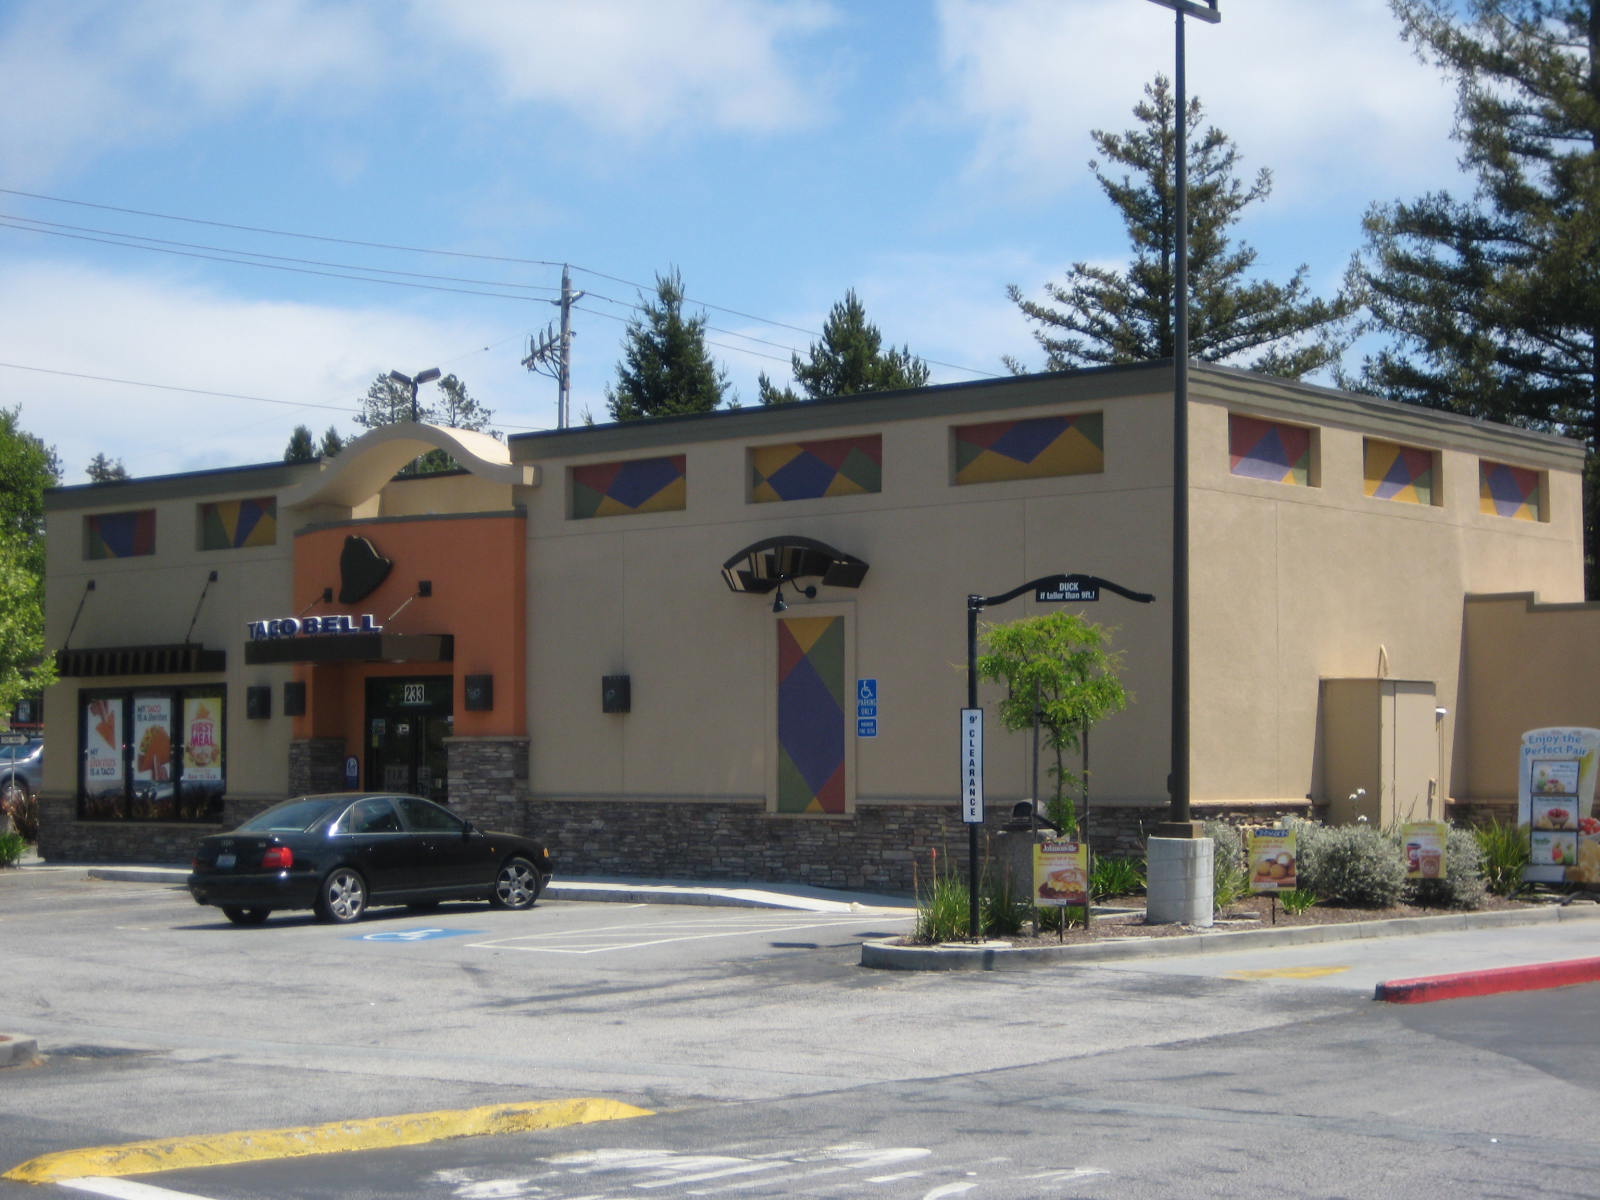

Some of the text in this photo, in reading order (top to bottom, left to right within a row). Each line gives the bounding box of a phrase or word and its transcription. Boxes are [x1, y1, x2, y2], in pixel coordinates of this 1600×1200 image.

[1059, 582, 1079, 591] DUCK
[1065, 591, 1080, 600] than
[247, 614, 383, 641] TACO BELL
[405, 685, 424, 702] 233
[1528, 734, 1582, 745] Enjoy the
[1525, 745, 1587, 755] Perfect Pair
